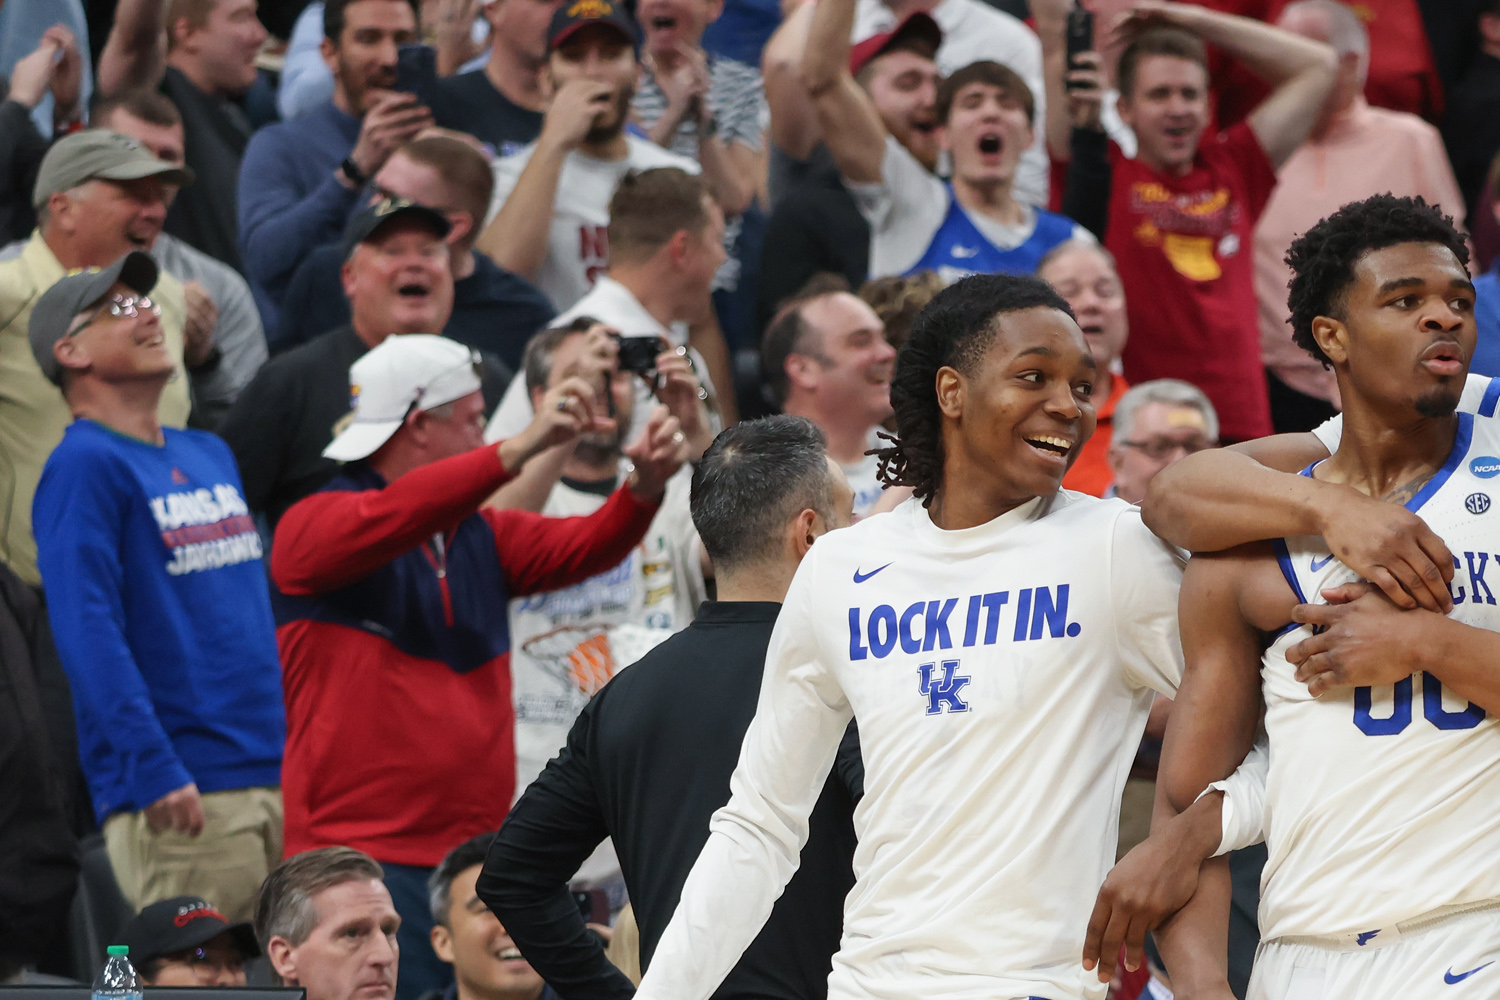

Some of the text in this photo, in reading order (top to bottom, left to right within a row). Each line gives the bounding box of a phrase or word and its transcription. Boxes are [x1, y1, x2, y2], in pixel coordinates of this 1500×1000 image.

[1466, 493, 1489, 513] SEC
[848, 583, 1082, 661] LOCK IT IN.
[917, 659, 971, 716] UK
